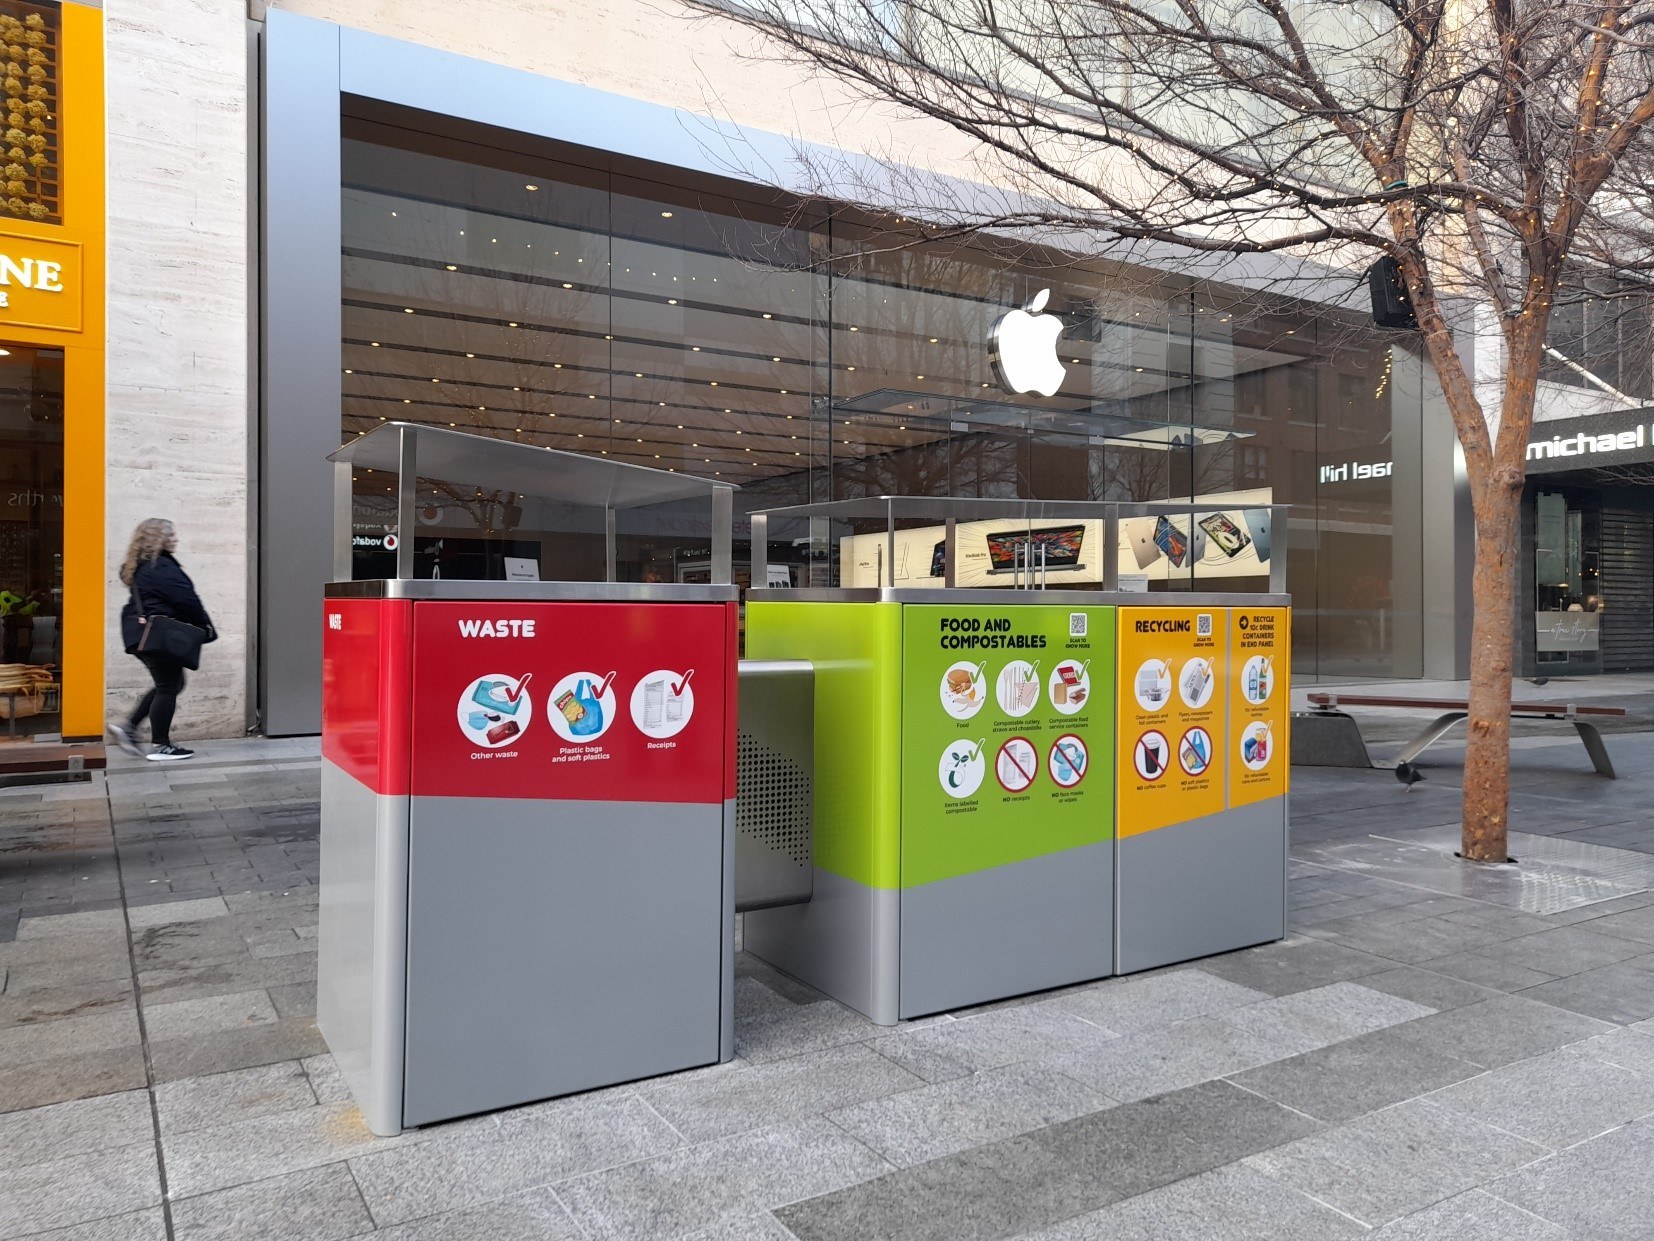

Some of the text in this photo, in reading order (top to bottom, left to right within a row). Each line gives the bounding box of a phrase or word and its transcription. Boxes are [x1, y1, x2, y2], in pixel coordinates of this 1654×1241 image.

[1525, 424, 1644, 460] michael
[1253, 615, 1275, 623] RECYCLE
[458, 619, 536, 638] WASTE
[940, 618, 1011, 632] FOOD AND
[1135, 619, 1191, 633] RECYCLING
[1259, 623, 1275, 631] DRINK
[1242, 632, 1275, 640] CONTAINERS
[940, 635, 1047, 649] COMPOSTABLES
[1258, 640, 1275, 648] PANEL
[559, 745, 603, 755] Plastic bags
[647, 742, 677, 750] Receipts
[470, 750, 519, 760] Other waste
[551, 752, 611, 763] and soft plastics
[945, 807, 978, 815] compostable
